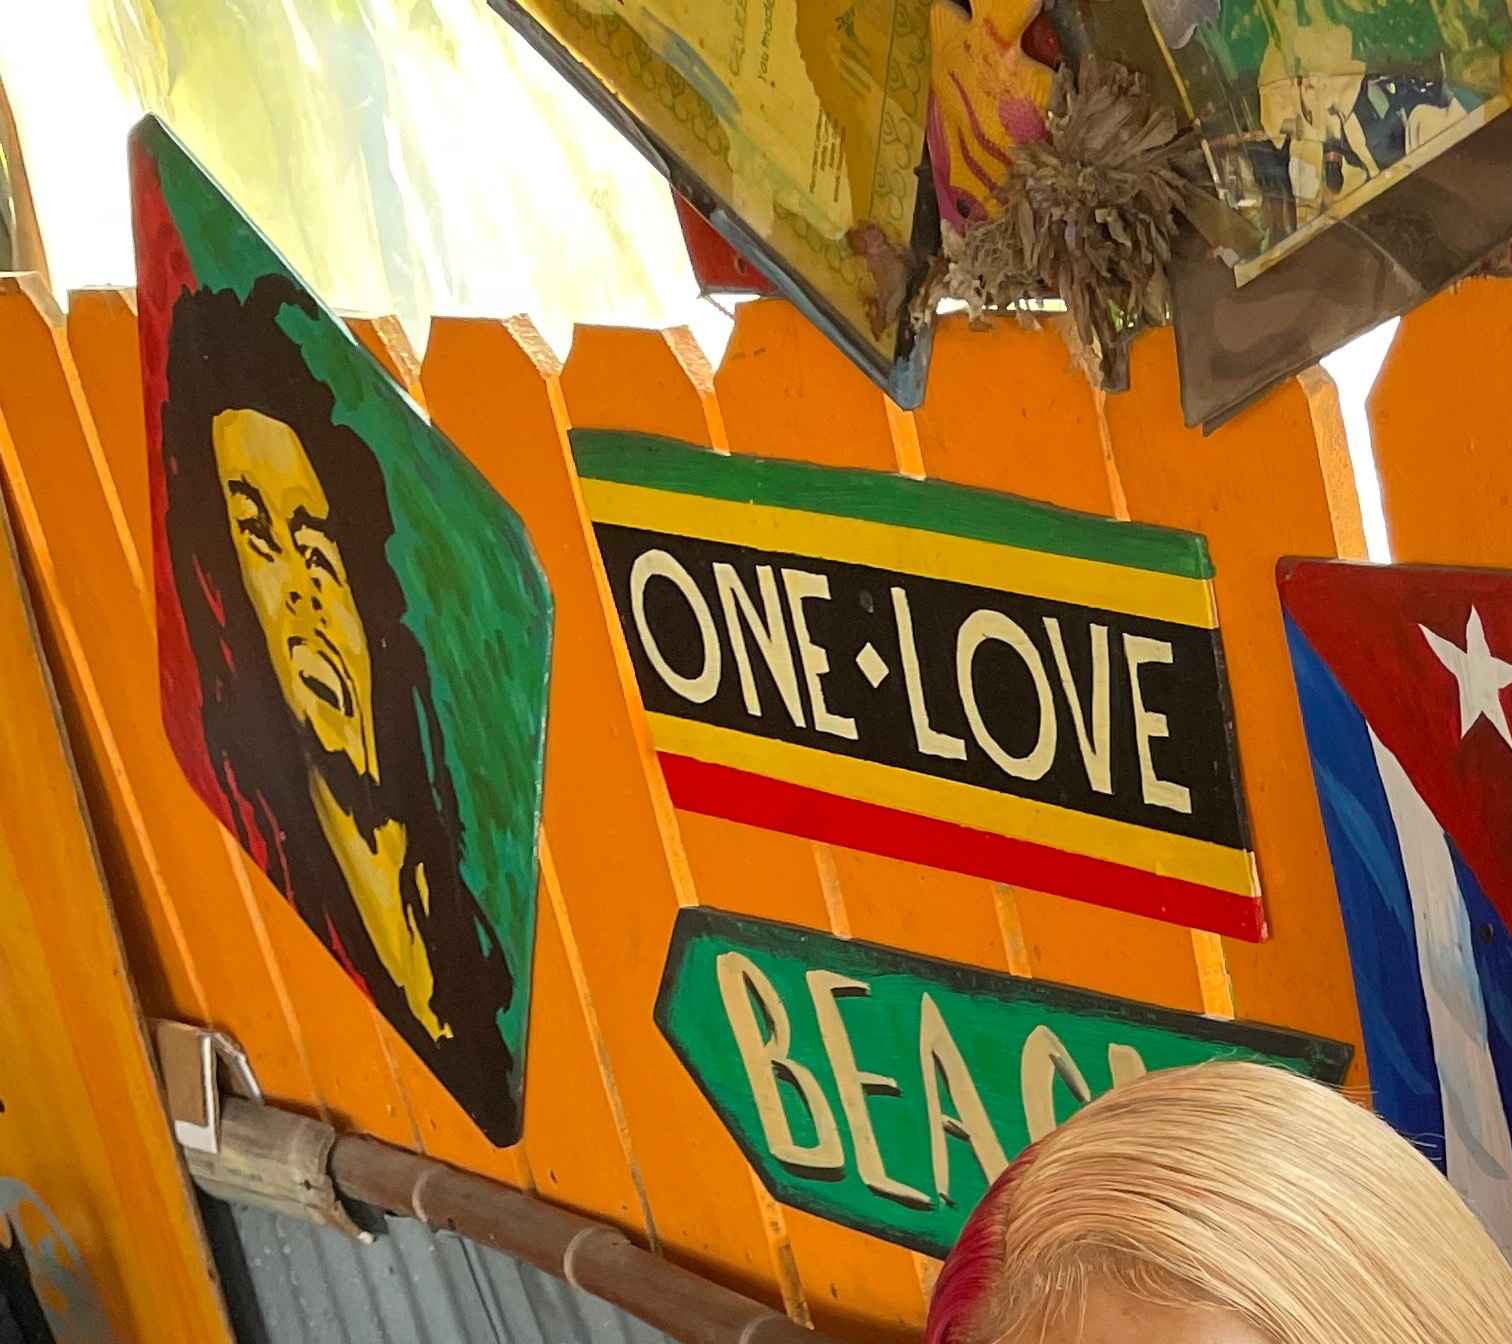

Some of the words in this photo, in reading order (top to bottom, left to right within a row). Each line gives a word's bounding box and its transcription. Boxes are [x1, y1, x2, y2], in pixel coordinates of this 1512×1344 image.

[630, 548, 859, 741] ONE
[890, 586, 1193, 814] LOVE
[715, 950, 1148, 1209] BEAC
